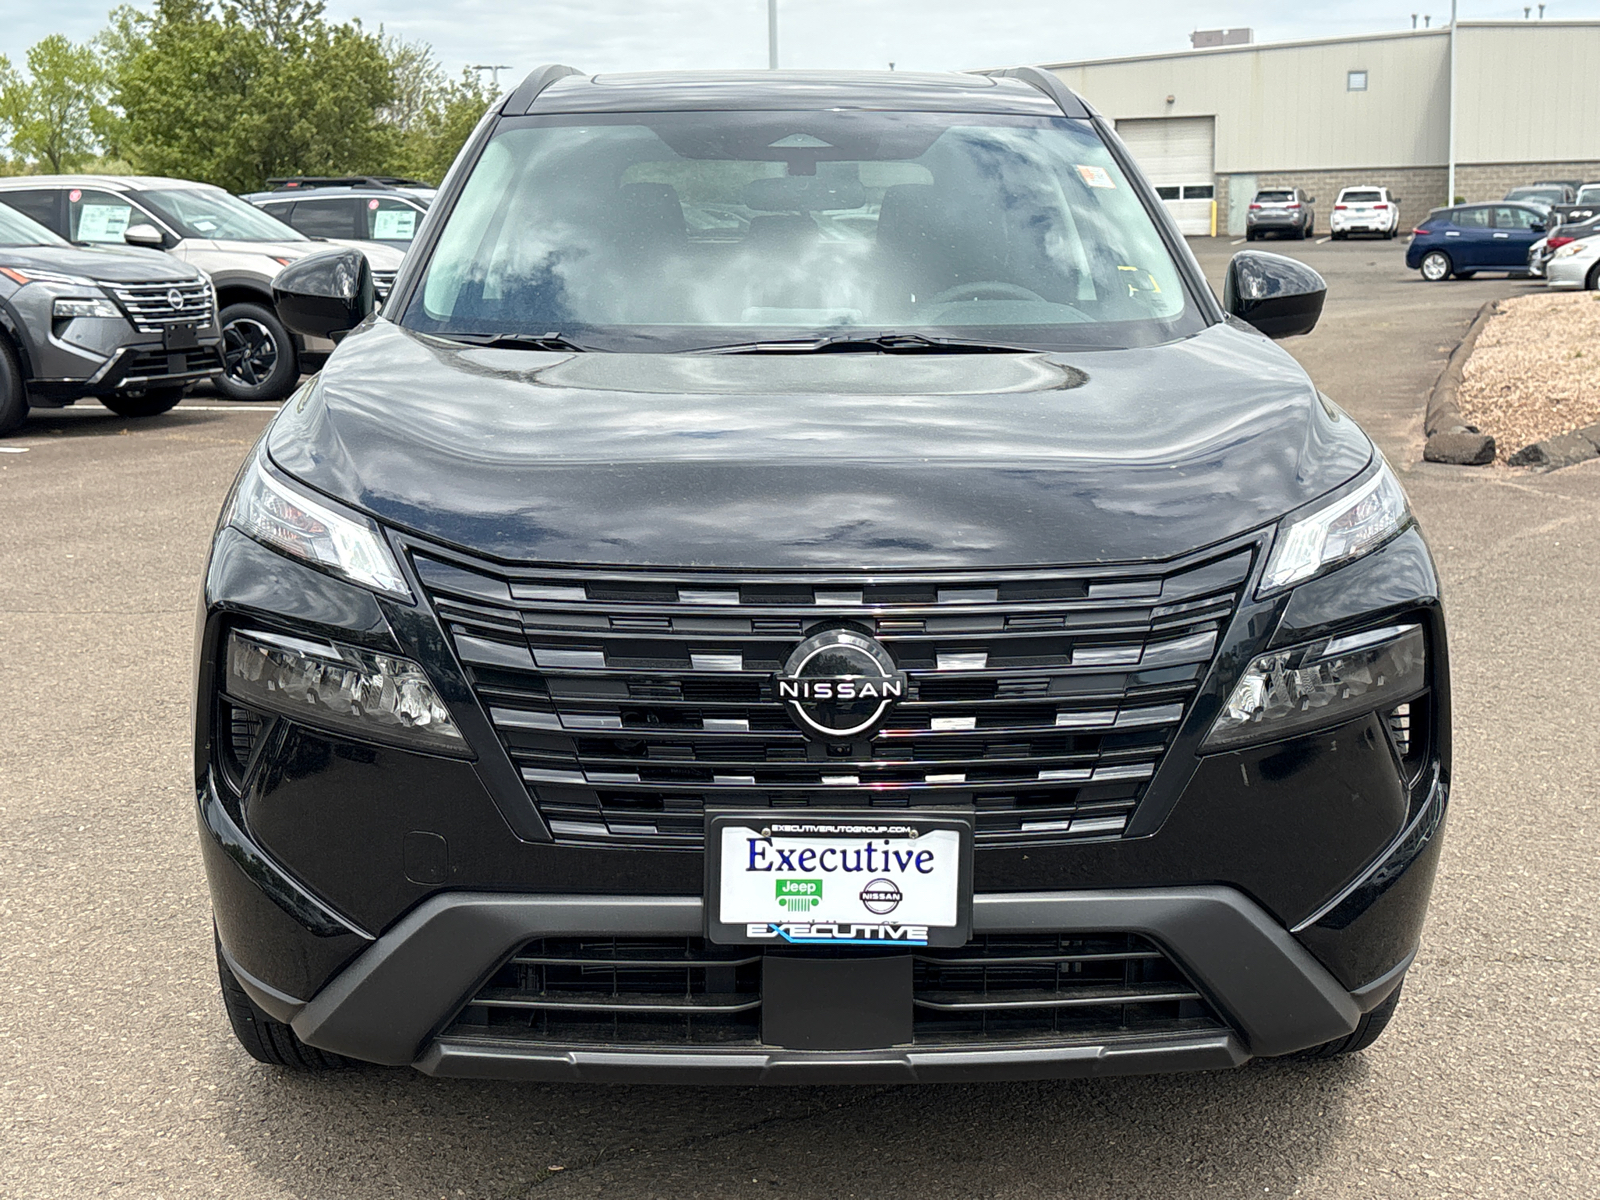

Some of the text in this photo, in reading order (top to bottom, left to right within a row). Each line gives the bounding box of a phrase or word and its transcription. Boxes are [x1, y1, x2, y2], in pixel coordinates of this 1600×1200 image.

[779, 681, 901, 698] NISSAN
[771, 824, 911, 834] EXECUTIVEAUTOGROUP.COM
[745, 837, 935, 874] Executive
[782, 881, 816, 895] Jeep
[862, 892, 900, 900] NISSAN
[746, 923, 929, 941] EXECUTIVE
